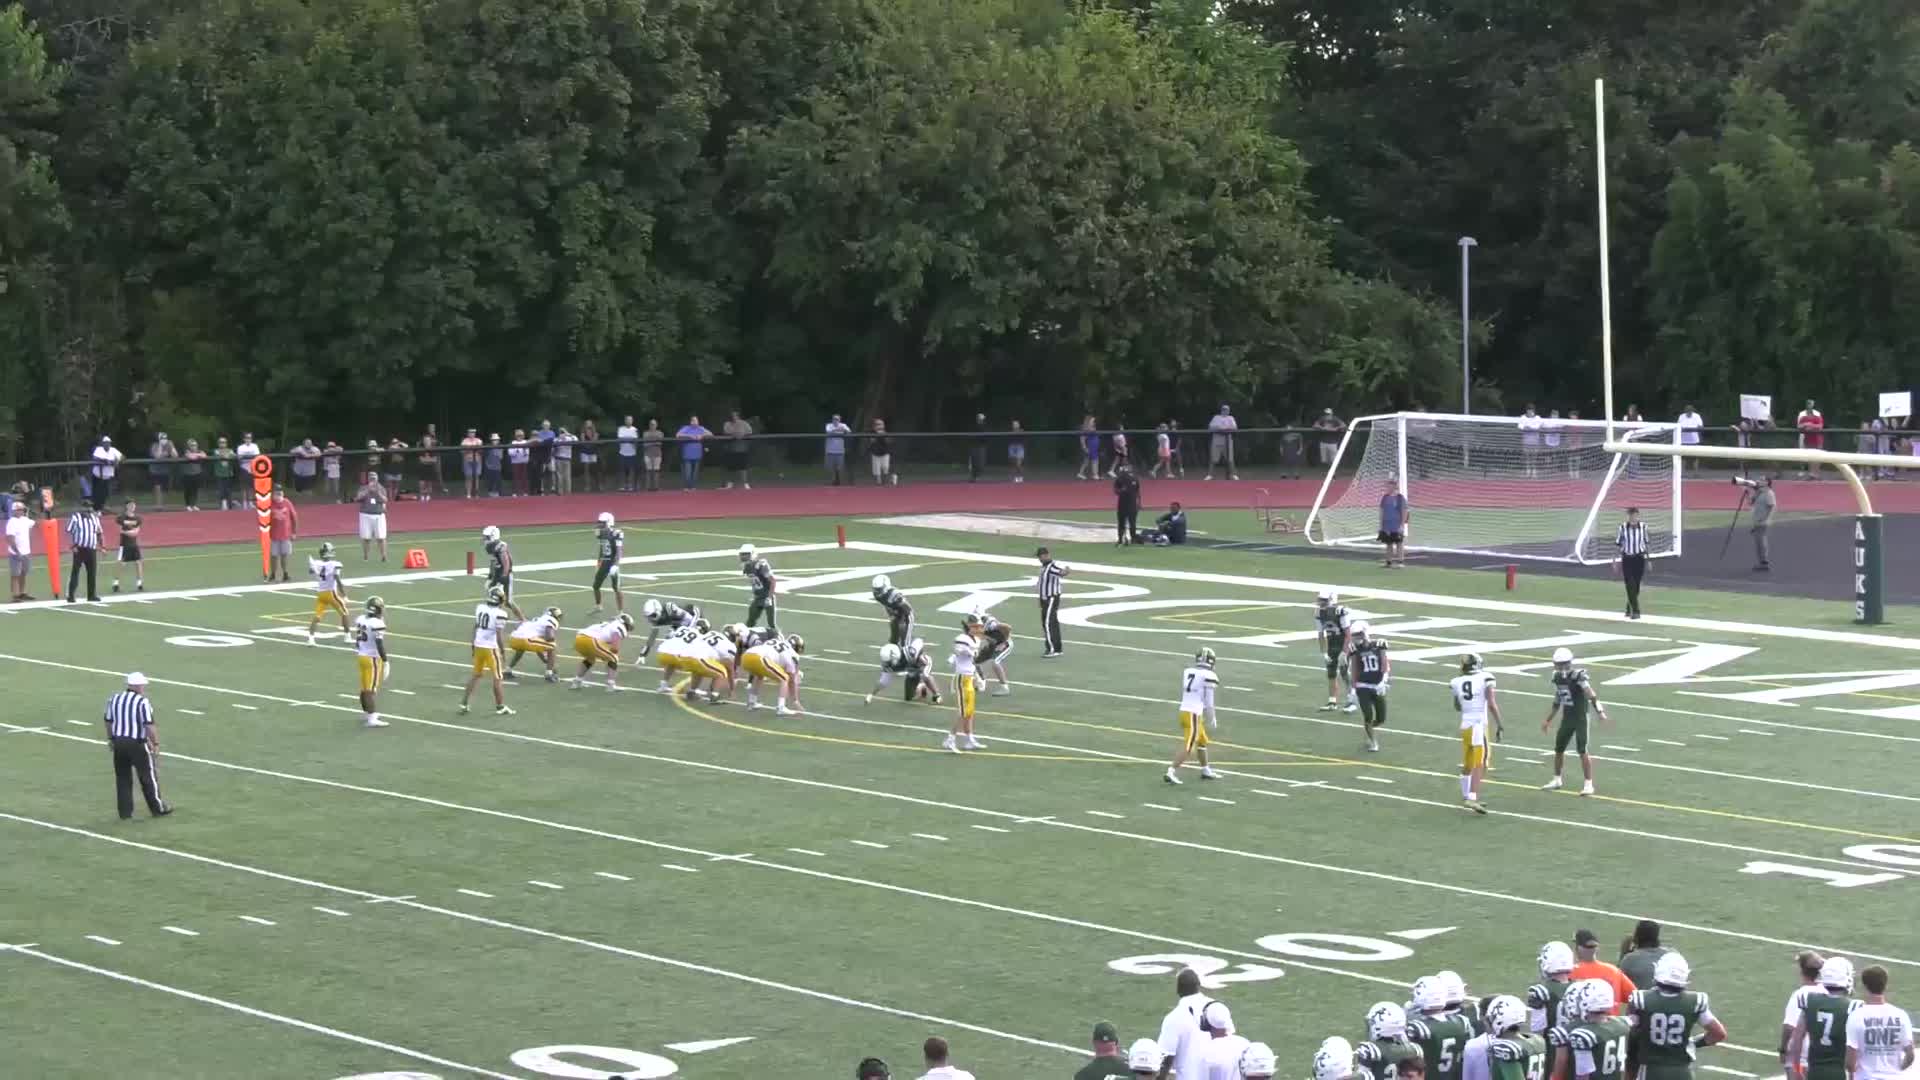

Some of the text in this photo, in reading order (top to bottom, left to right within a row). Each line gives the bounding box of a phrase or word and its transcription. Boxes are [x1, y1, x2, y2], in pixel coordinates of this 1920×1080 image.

[319, 565, 327, 581] 4
[477, 612, 490, 631] 10
[675, 625, 698, 644] 59
[1361, 655, 1379, 673] 10
[1186, 673, 1196, 692] 7
[1461, 680, 1474, 701] 9
[1107, 932, 1414, 989] 20
[1650, 1012, 1686, 1046] 82
[1816, 1010, 1835, 1047] 7
[1864, 1028, 1901, 1045] ONE
[1603, 1035, 1628, 1075] 64
